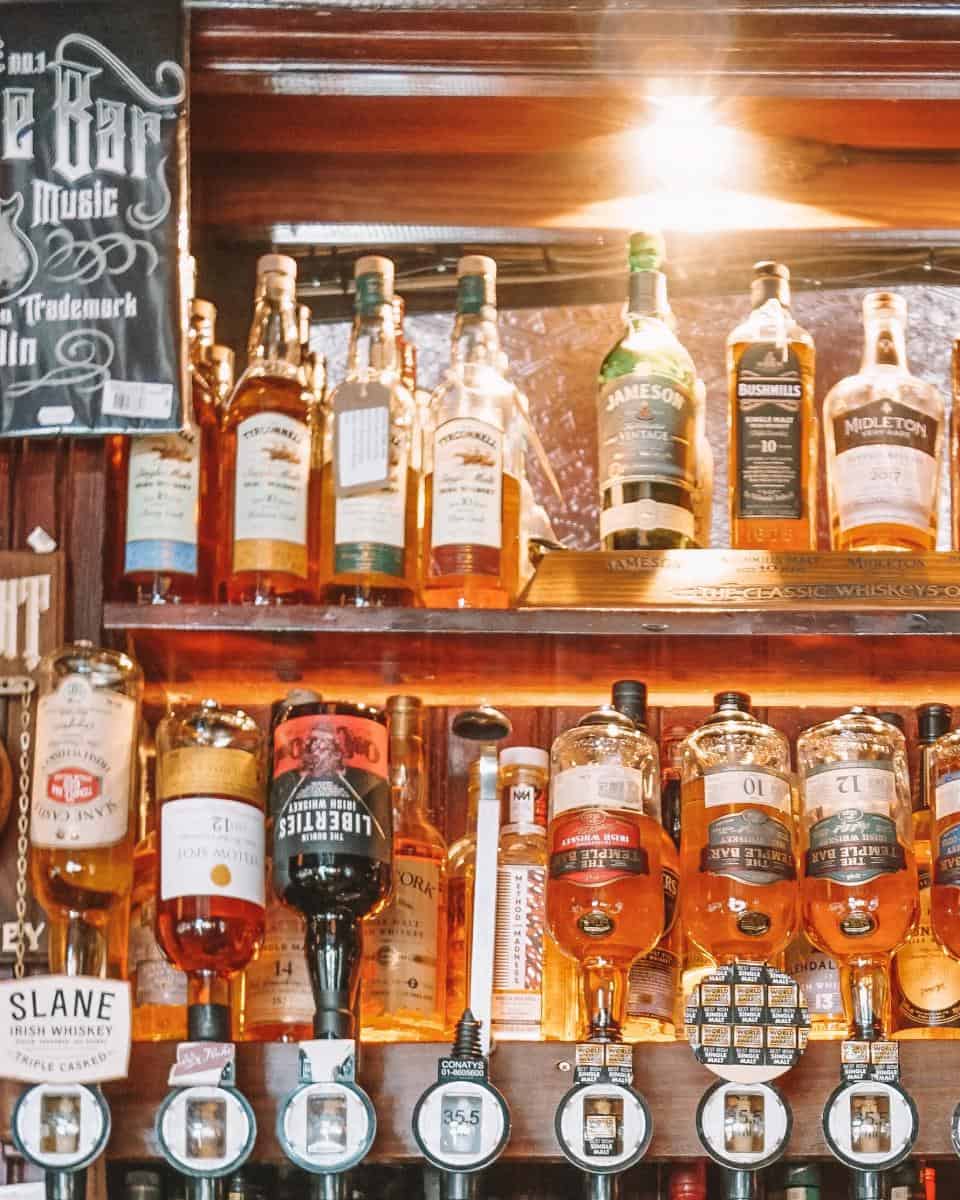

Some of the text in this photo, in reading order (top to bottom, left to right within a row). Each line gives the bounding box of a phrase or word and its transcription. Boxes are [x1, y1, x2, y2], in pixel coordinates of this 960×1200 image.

[48, 60, 174, 182] Bar
[32, 178, 118, 227] Music
[18, 292, 138, 327] Trademark
[606, 383, 685, 411] JAMESON
[738, 384, 801, 397] BUSHMILLS
[844, 416, 927, 438] MIDLETON
[743, 585, 826, 599] CLASSIC
[836, 585, 938, 599] WHISKEYS
[743, 776, 764, 797] 10
[836, 776, 861, 793] 12
[289, 799, 327, 812] WHISKEY
[279, 810, 372, 840] LIBERTIES
[711, 847, 741, 860] BAR
[812, 846, 897, 861] TEMPLE BAR
[840, 857, 865, 866] THE
[398, 871, 437, 899] ORK
[10, 988, 116, 1021] SLANE
[10, 1025, 113, 1037] IRISH WHISKEY
[15, 1051, 112, 1072] TRIPLE CASKED
[441, 1060, 484, 1069] CONATYS
